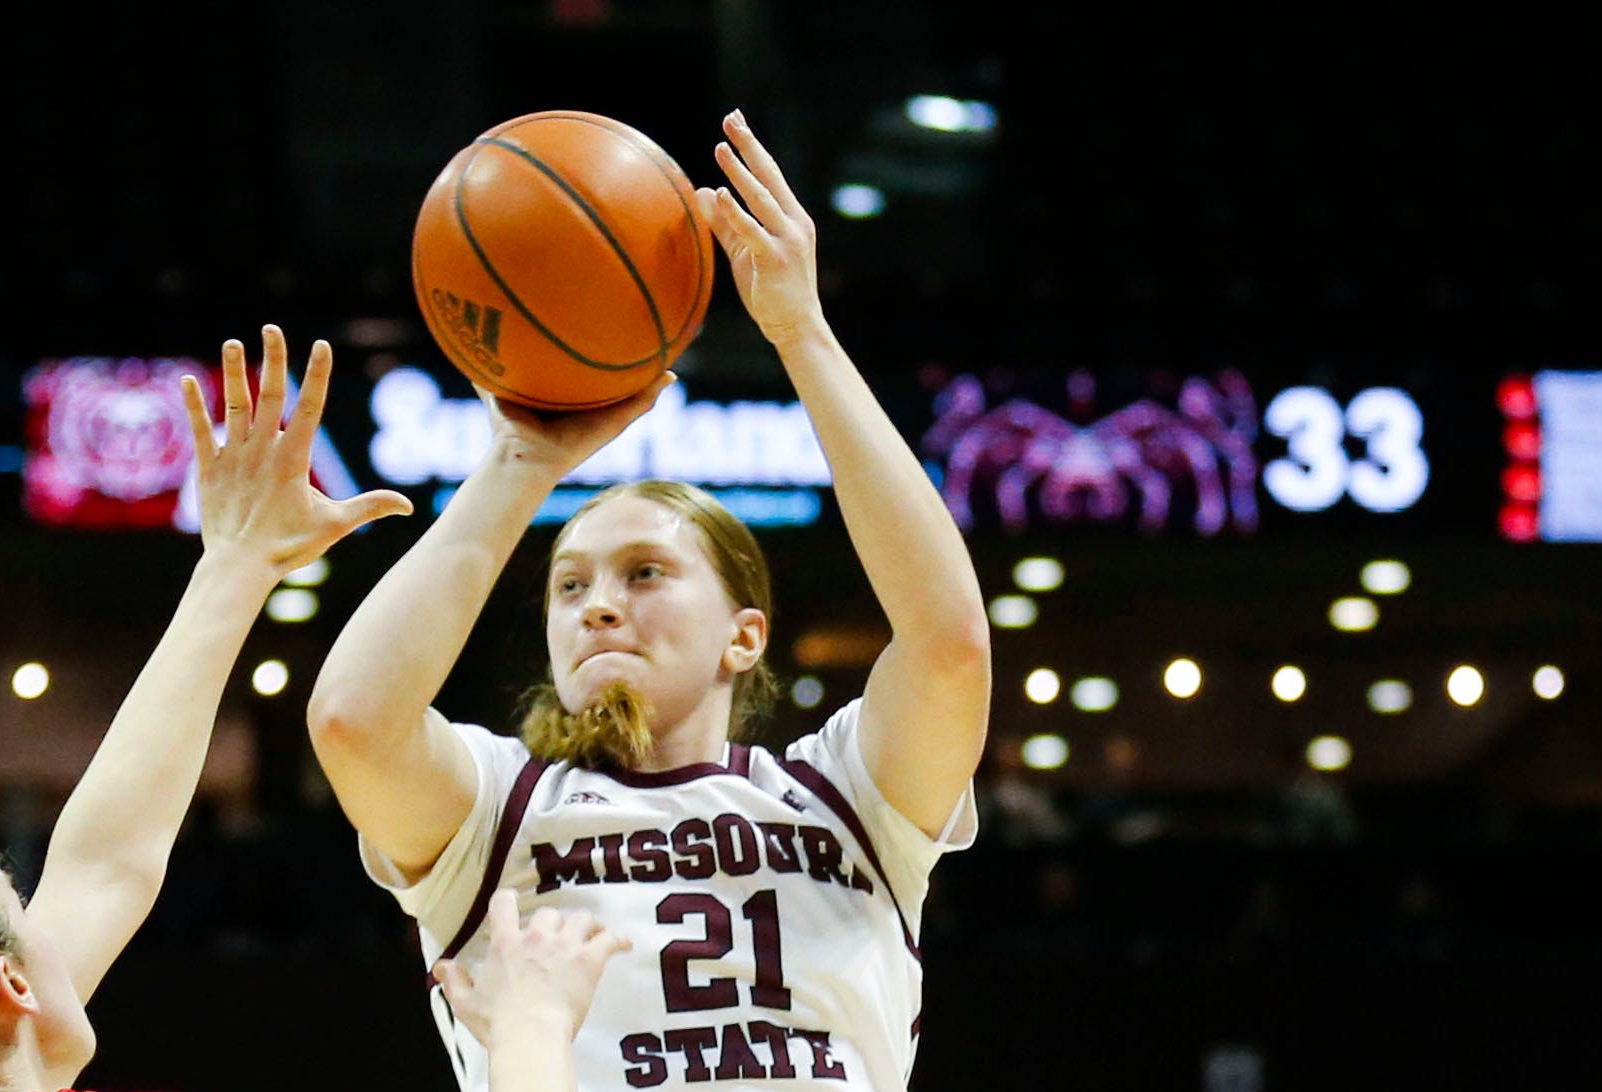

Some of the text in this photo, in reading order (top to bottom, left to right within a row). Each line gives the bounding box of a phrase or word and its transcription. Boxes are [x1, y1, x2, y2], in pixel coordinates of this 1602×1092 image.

[1263, 385, 1428, 513] 33
[655, 888, 792, 1014] 21
[619, 1020, 848, 1089] STATE
